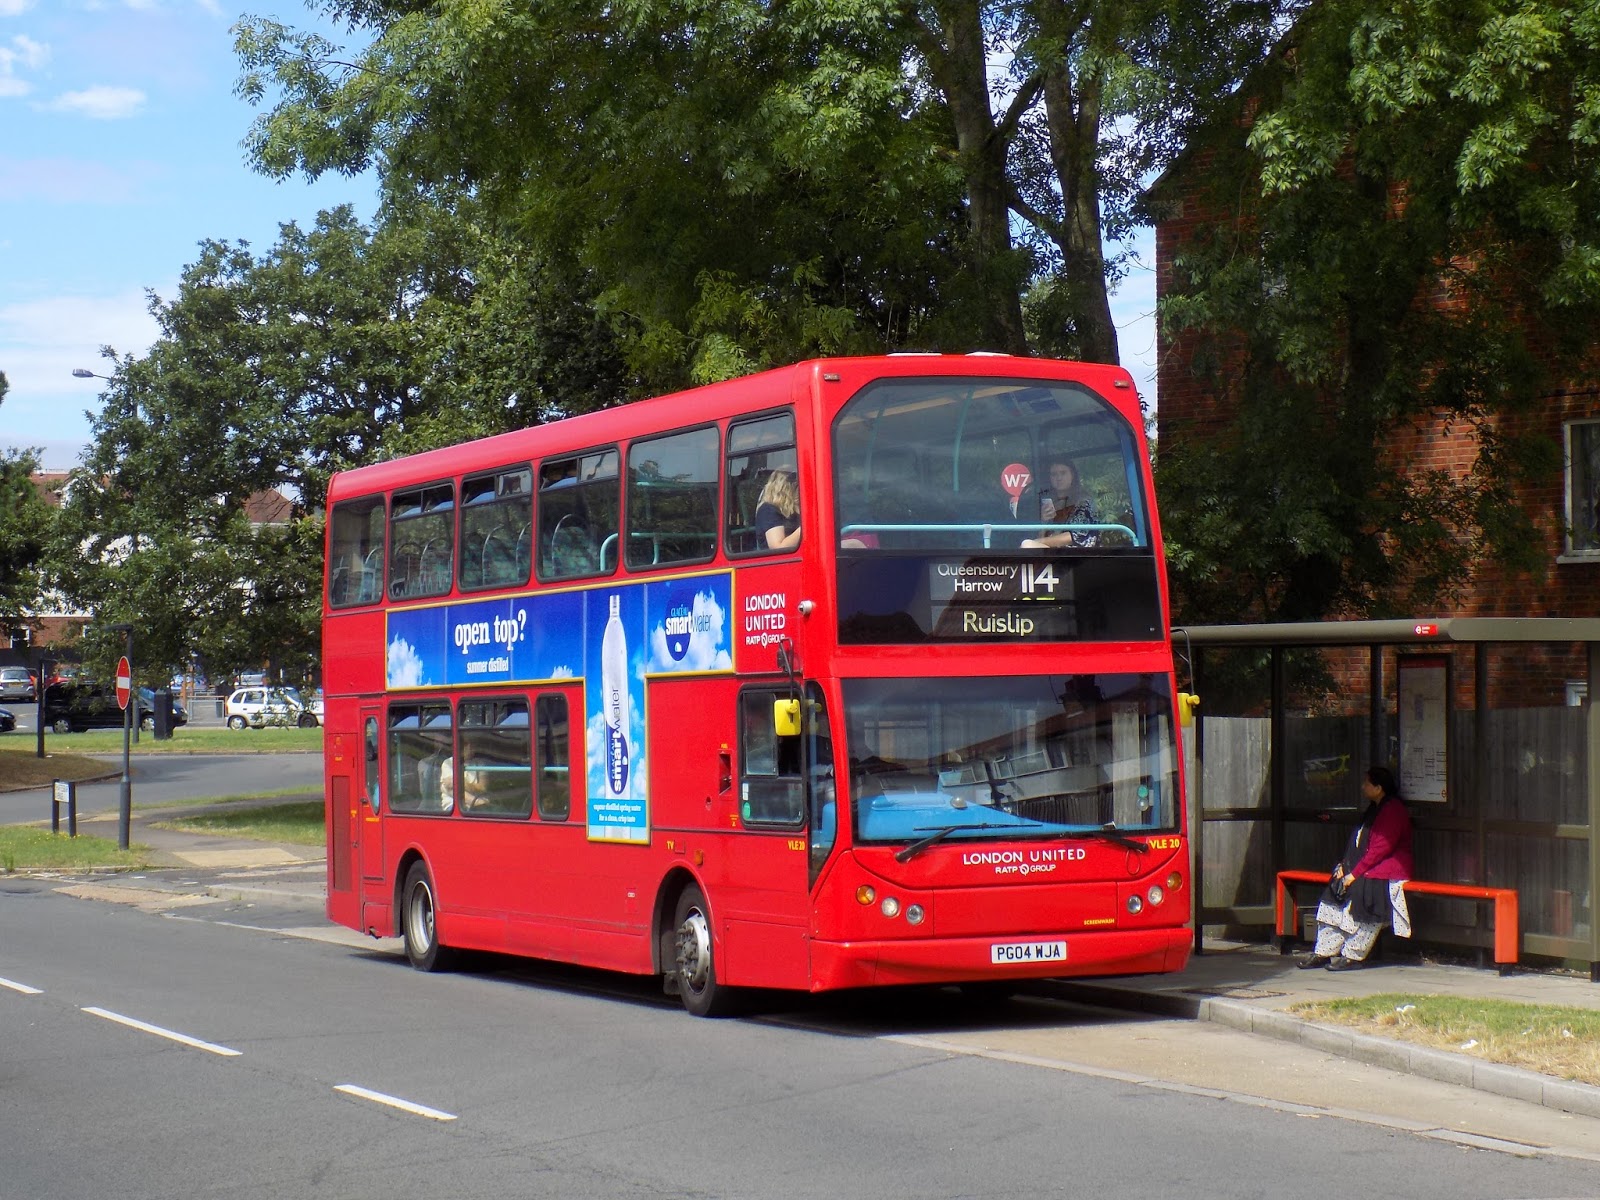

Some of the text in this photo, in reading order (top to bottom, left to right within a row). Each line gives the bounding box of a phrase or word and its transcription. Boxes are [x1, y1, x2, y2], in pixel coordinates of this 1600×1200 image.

[1004, 473, 1030, 488] W7
[937, 563, 1018, 579] Queensbury
[1021, 563, 1059, 593] 114
[954, 578, 1003, 592] Harrow
[745, 593, 785, 611] LONDON
[745, 613, 785, 632] UNITED
[963, 610, 1034, 637] Ruislip
[454, 608, 527, 655] open top?
[745, 635, 761, 646] RATP
[466, 656, 509, 674] summer distilled
[788, 840, 806, 851] VLE 20
[1149, 838, 1181, 849] VLE 20
[963, 848, 1086, 865] LONDON UNITED
[995, 863, 1057, 875] RATP GROUP
[1083, 918, 1115, 926] SCREENWASH
[997, 944, 1061, 961] PG04 WJA
